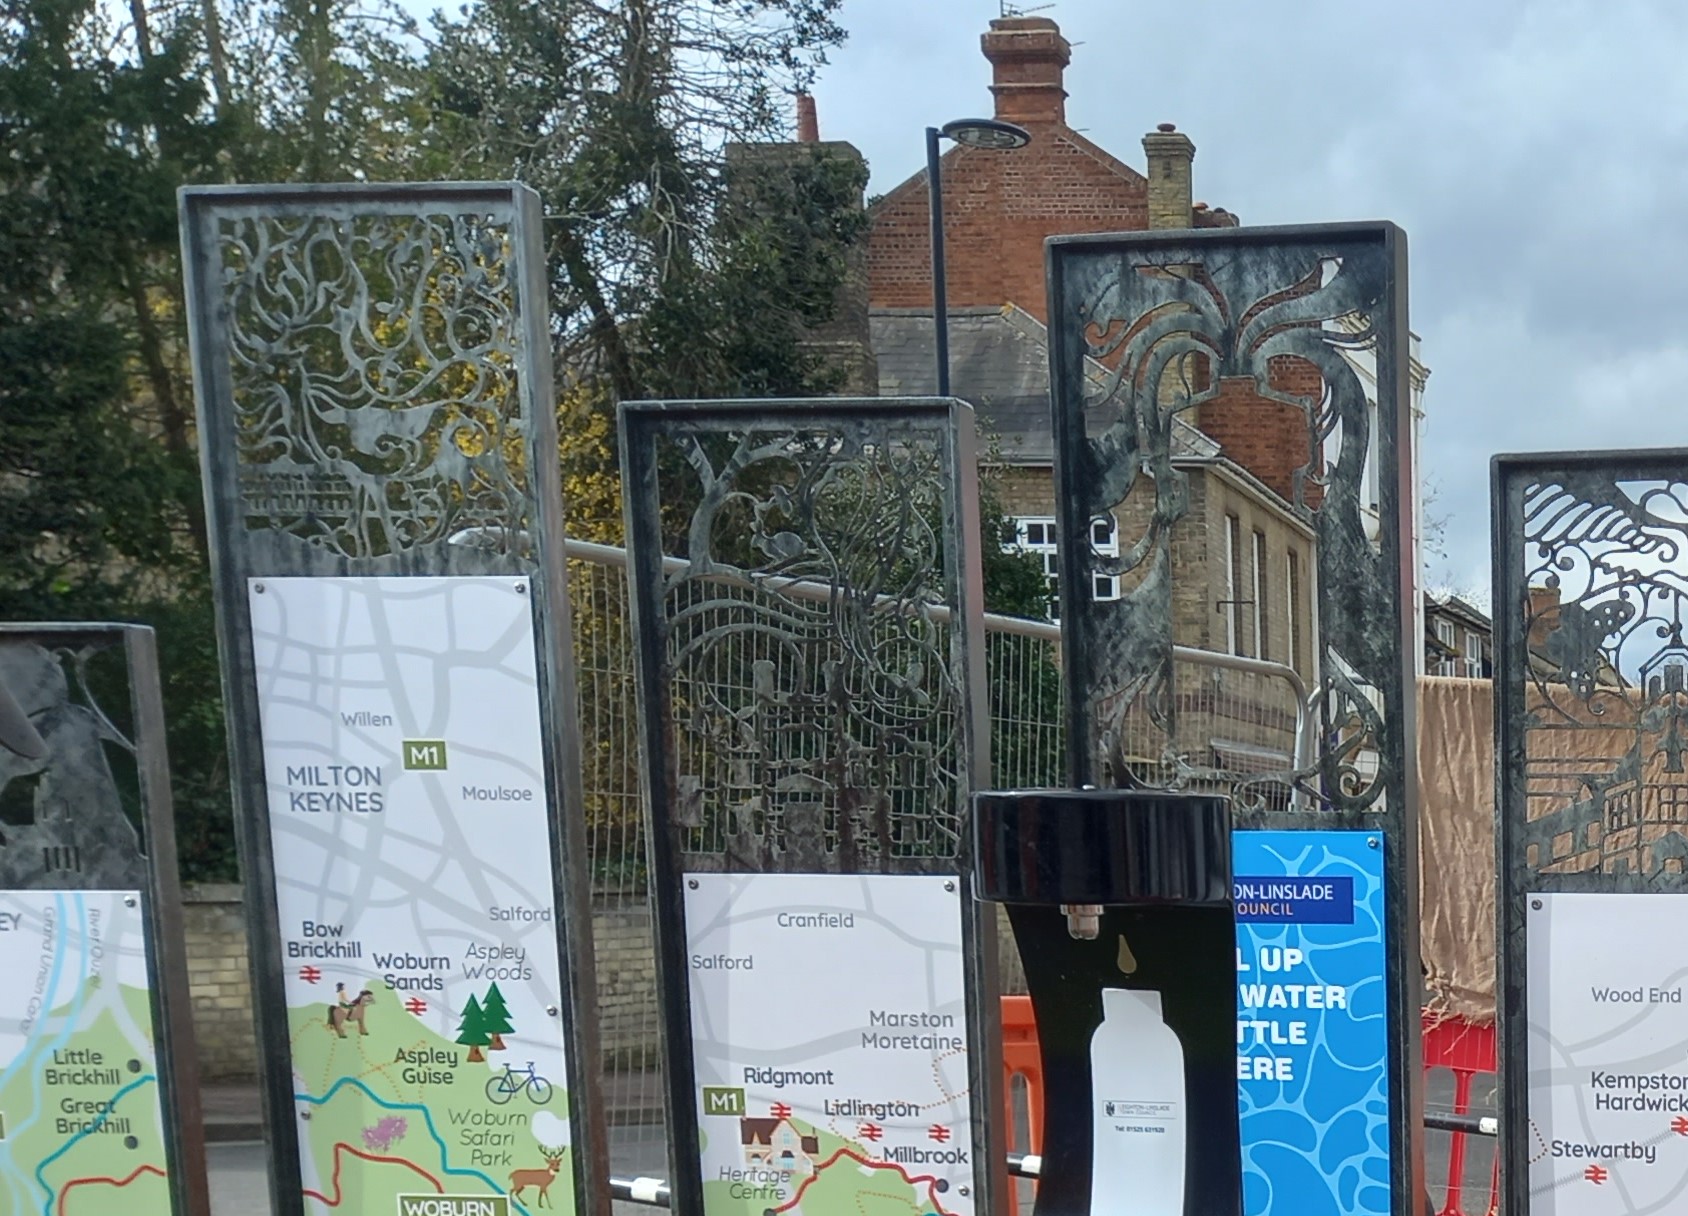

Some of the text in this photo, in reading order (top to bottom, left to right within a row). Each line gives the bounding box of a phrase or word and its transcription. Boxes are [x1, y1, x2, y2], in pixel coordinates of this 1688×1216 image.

[341, 712, 393, 727] Willen
[411, 747, 438, 766] M1
[287, 766, 381, 787] MILTON
[462, 785, 532, 801] Moulsoe
[290, 792, 383, 813] KEYNES
[1234, 884, 1333, 900] ON-LINSLADE
[489, 906, 551, 922] Salford
[1237, 903, 1293, 915] OUNCIL
[303, 921, 344, 938] Bow
[778, 913, 854, 929] Cranfield
[288, 941, 361, 959] Brickhill
[465, 942, 526, 963] Aspley
[373, 953, 450, 970] Woburn
[692, 954, 753, 970] Salford
[1261, 948, 1303, 972] UP
[462, 962, 532, 981] Woods
[385, 974, 444, 991] Sands
[1240, 984, 1346, 1009] WATER
[1592, 988, 1682, 1003] Wood End
[870, 1011, 953, 1028] Marston
[1237, 1021, 1307, 1044] TTLE
[862, 1033, 962, 1050] Moretaine
[54, 1050, 102, 1065] Little
[395, 1048, 458, 1069] Aspley
[402, 1067, 454, 1085] Guise
[744, 1067, 833, 1087] Ridgmont
[1237, 1057, 1293, 1080] ERE
[46, 1070, 120, 1085] Brickhill
[60, 1098, 116, 1114] Great
[710, 1092, 738, 1111] M1
[825, 1100, 920, 1119] Lidlington
[56, 1118, 130, 1134] Brickhill
[884, 1147, 968, 1164] Millbrook
[1551, 1141, 1656, 1163] Stewartby
